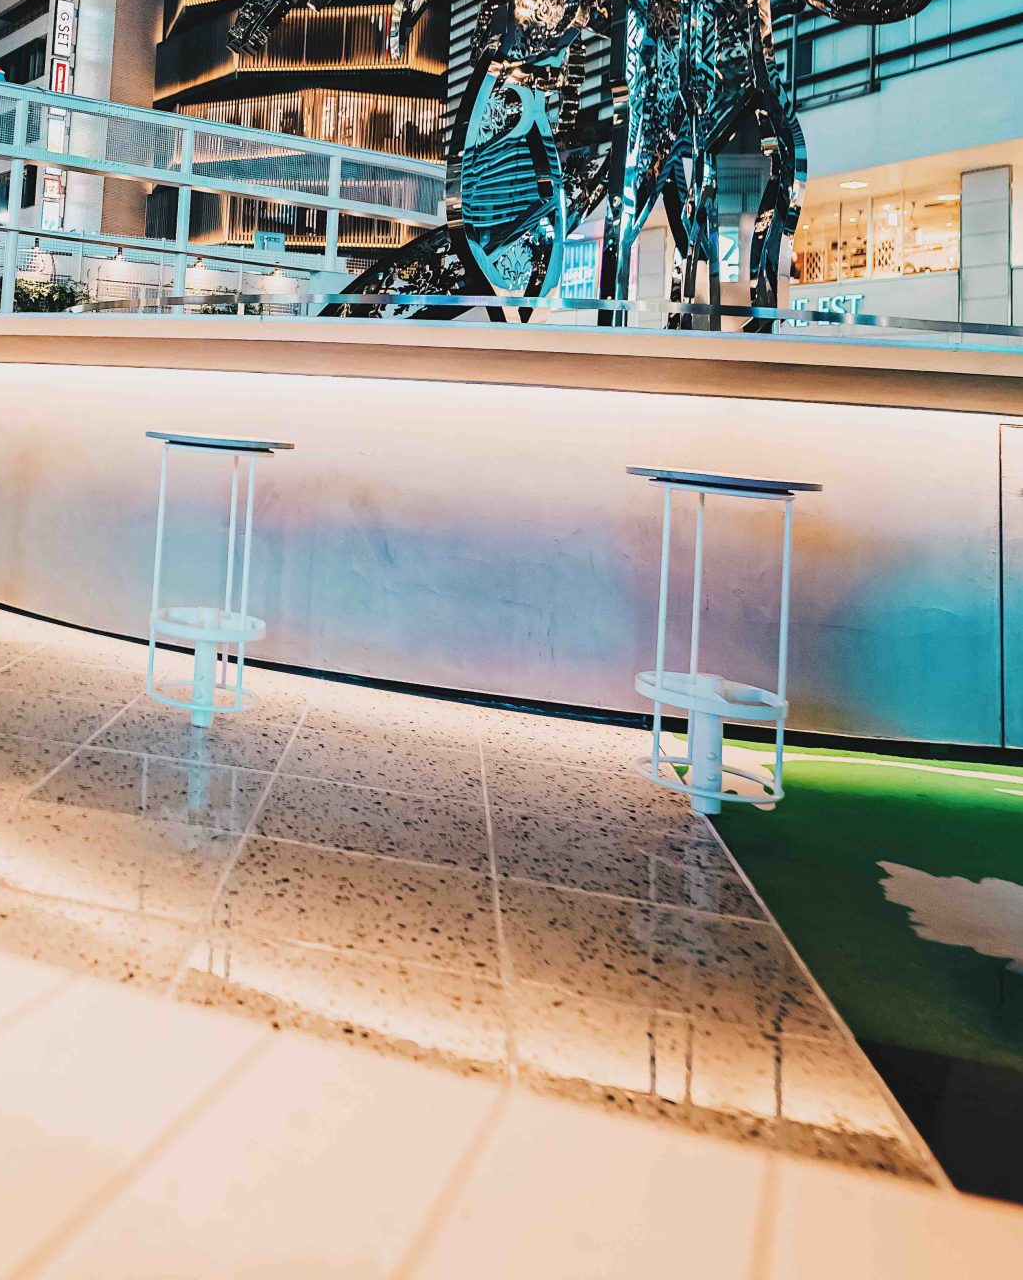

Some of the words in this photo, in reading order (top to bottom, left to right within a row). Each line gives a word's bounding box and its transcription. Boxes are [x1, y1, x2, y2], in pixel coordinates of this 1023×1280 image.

[60, 11, 70, 22] G
[57, 24, 70, 49] SET
[818, 293, 864, 326] EST
